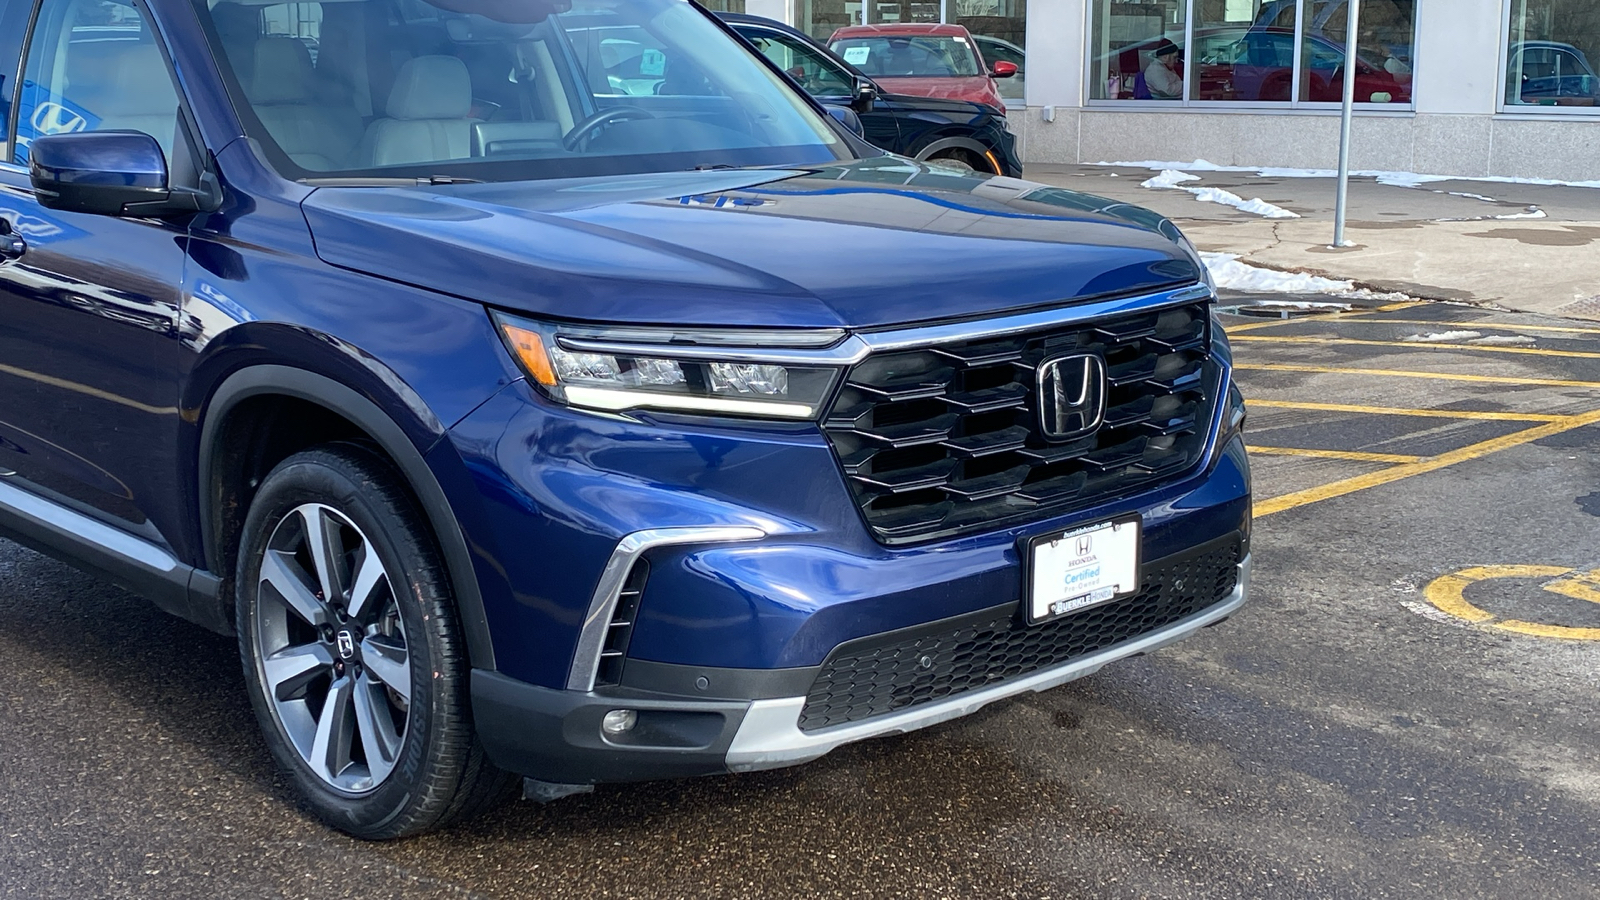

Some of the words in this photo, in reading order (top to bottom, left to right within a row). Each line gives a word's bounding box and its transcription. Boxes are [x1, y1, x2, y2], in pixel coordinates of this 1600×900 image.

[1068, 554, 1098, 567] HONDA
[1064, 566, 1100, 584] Certified
[1064, 578, 1100, 593] Pre-Owned
